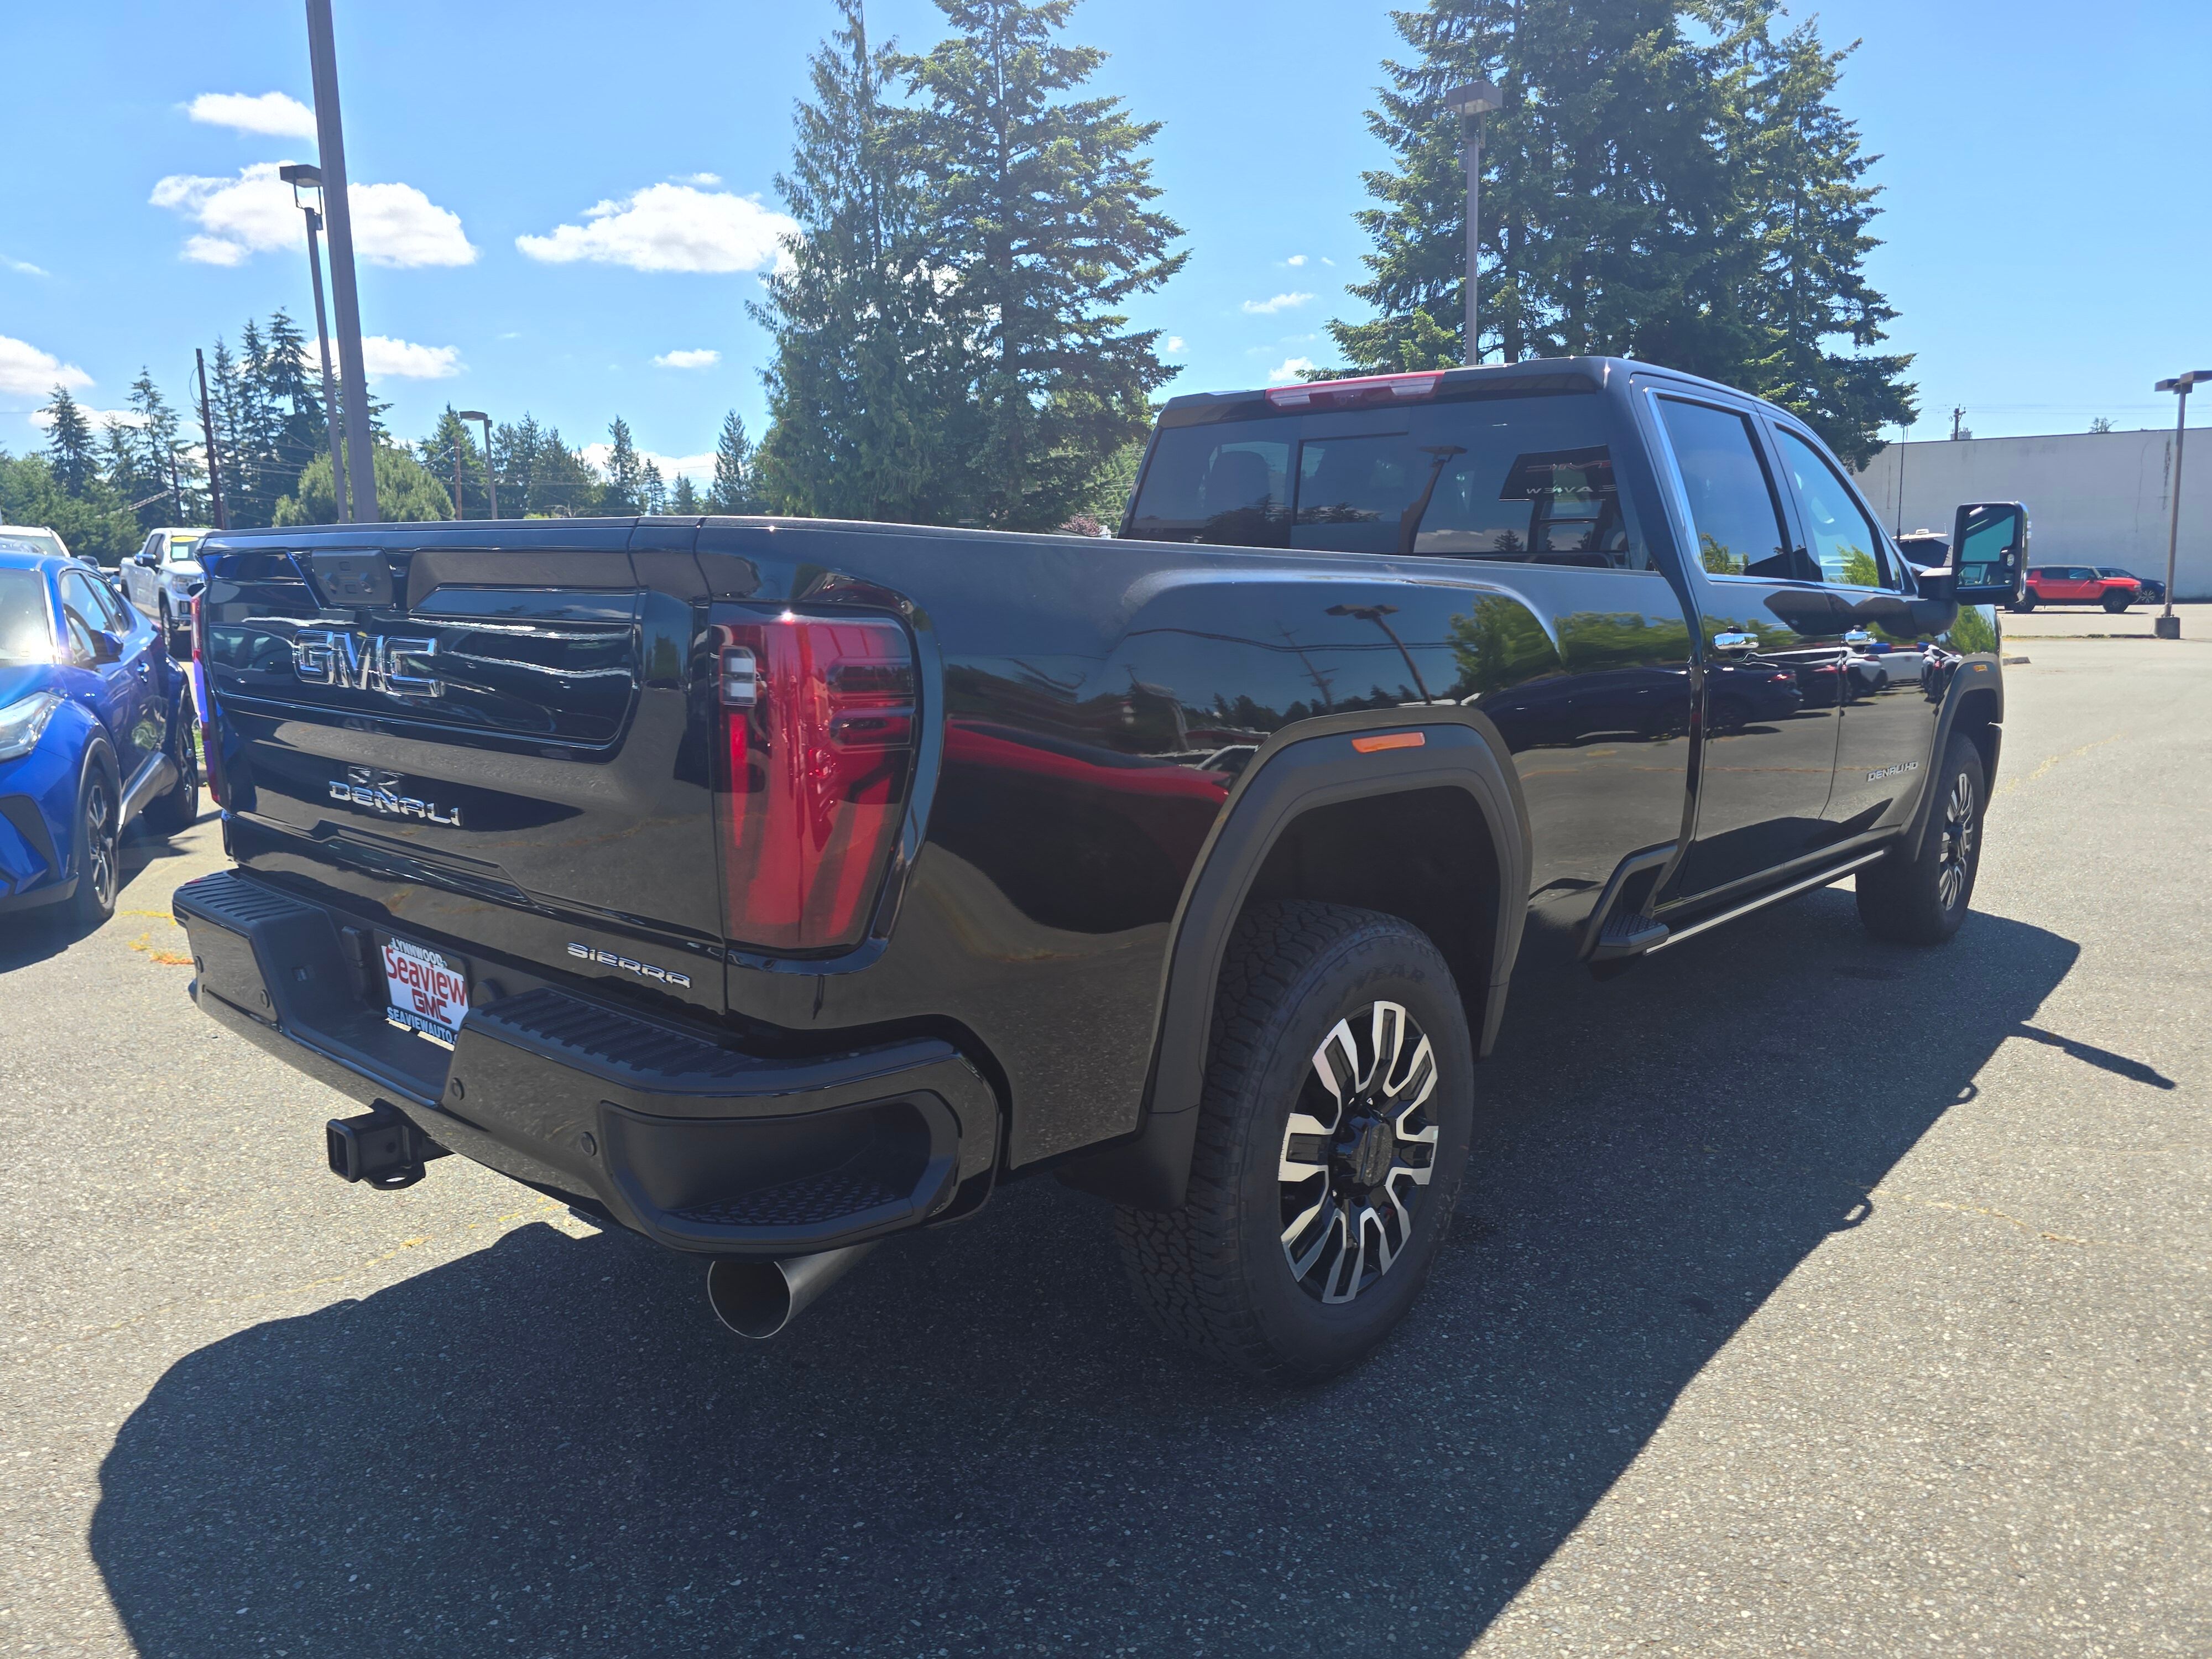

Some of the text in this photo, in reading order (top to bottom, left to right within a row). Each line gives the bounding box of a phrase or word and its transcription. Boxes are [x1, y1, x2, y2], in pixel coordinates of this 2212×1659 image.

[292, 629, 445, 697] GMC
[329, 781, 463, 826] DENALI
[392, 938, 444, 967] LYNNWOOD
[567, 943, 691, 989] SIERRA
[385, 945, 467, 1006] Seaview
[411, 988, 452, 1024] GMC
